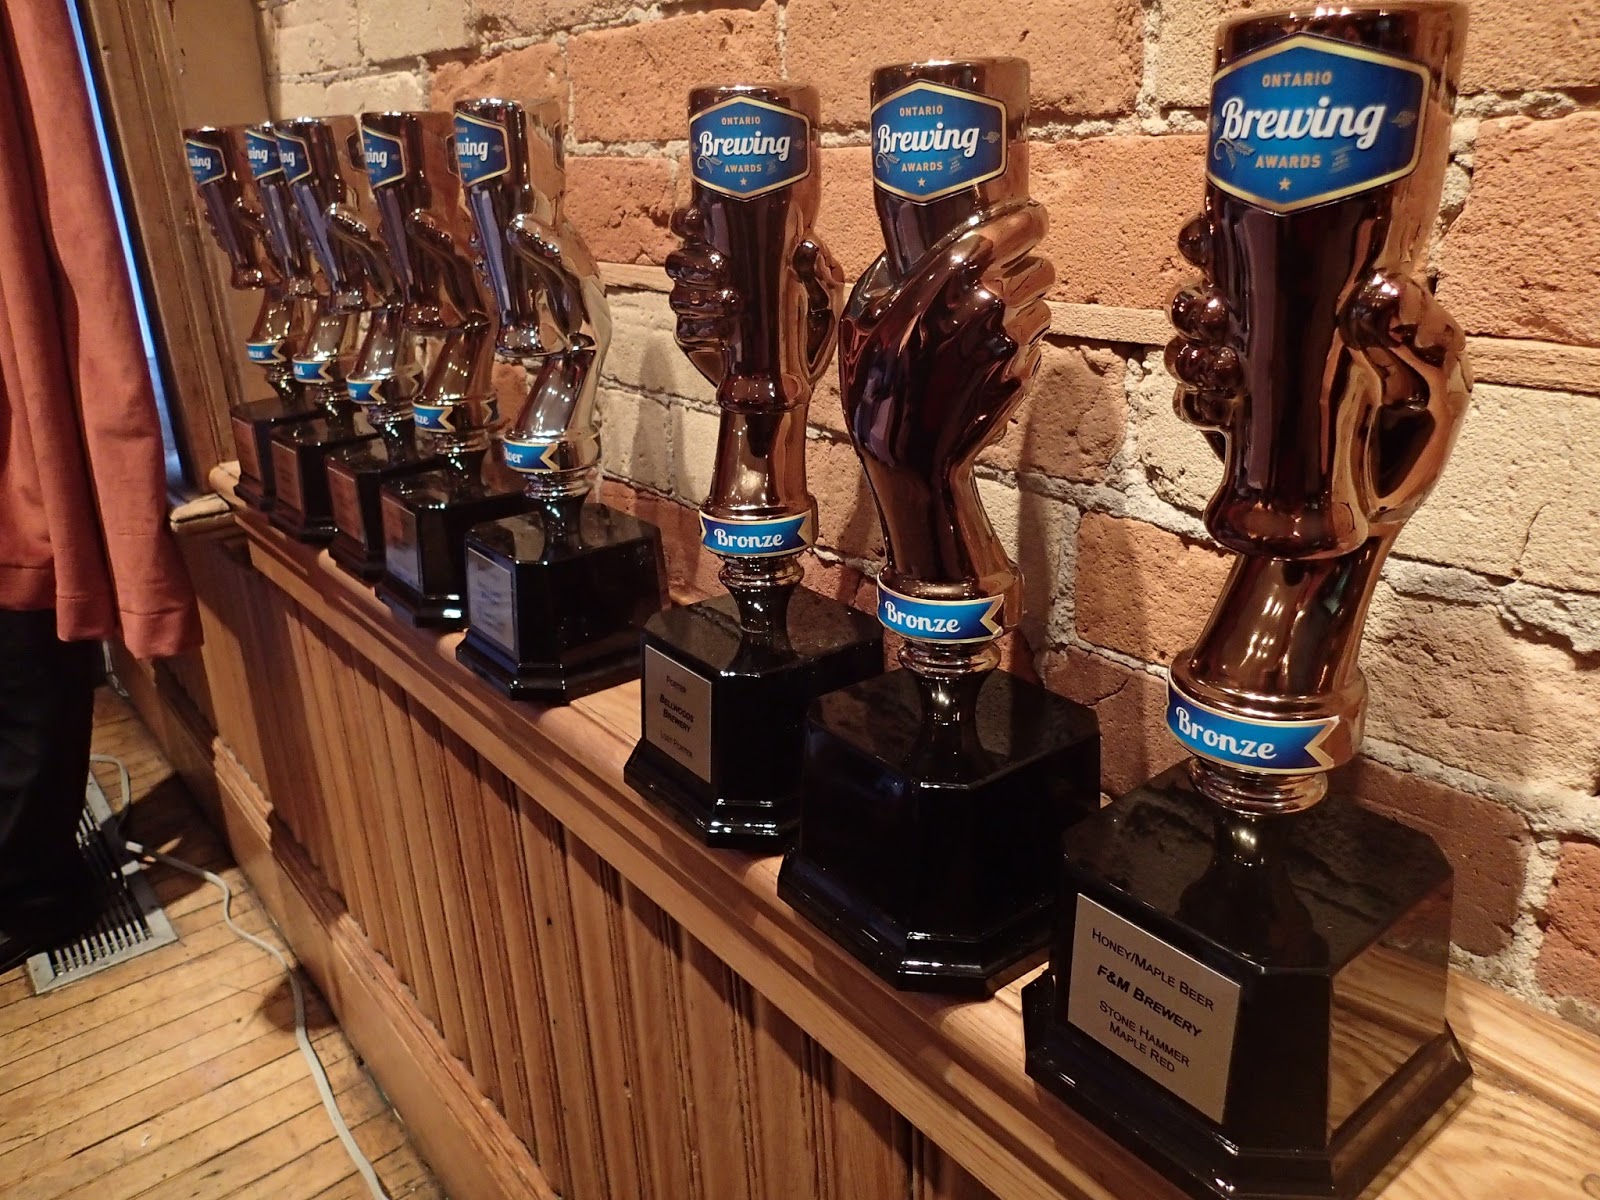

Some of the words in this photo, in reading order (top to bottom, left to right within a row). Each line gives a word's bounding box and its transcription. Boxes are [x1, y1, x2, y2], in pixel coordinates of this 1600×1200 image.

[1261, 70, 1333, 88] ONTARIO
[720, 115, 762, 126] ONTARIO
[898, 104, 944, 118] ONTARIO
[1221, 96, 1387, 151] Brewing
[698, 130, 791, 162] Brewing
[876, 121, 981, 158] Brewing
[723, 162, 763, 174] AWARDS
[900, 160, 944, 173] AWARDS
[1254, 153, 1322, 169] AWARDS
[713, 528, 785, 548] Bronze
[884, 600, 961, 633] Bronze
[662, 708, 692, 733] BREWERY
[1174, 706, 1278, 760] Bronze
[1091, 927, 1176, 988] HONEY/MAPLE
[1179, 981, 1214, 1012] BEER
[1096, 964, 1130, 994] F&M
[1132, 987, 1202, 1037] BREWERY
[1099, 1000, 1136, 1032] STONE
[1139, 1025, 1190, 1068] HAMMER
[1109, 1021, 1147, 1055] MAPLE
[1149, 1048, 1176, 1073] RED
